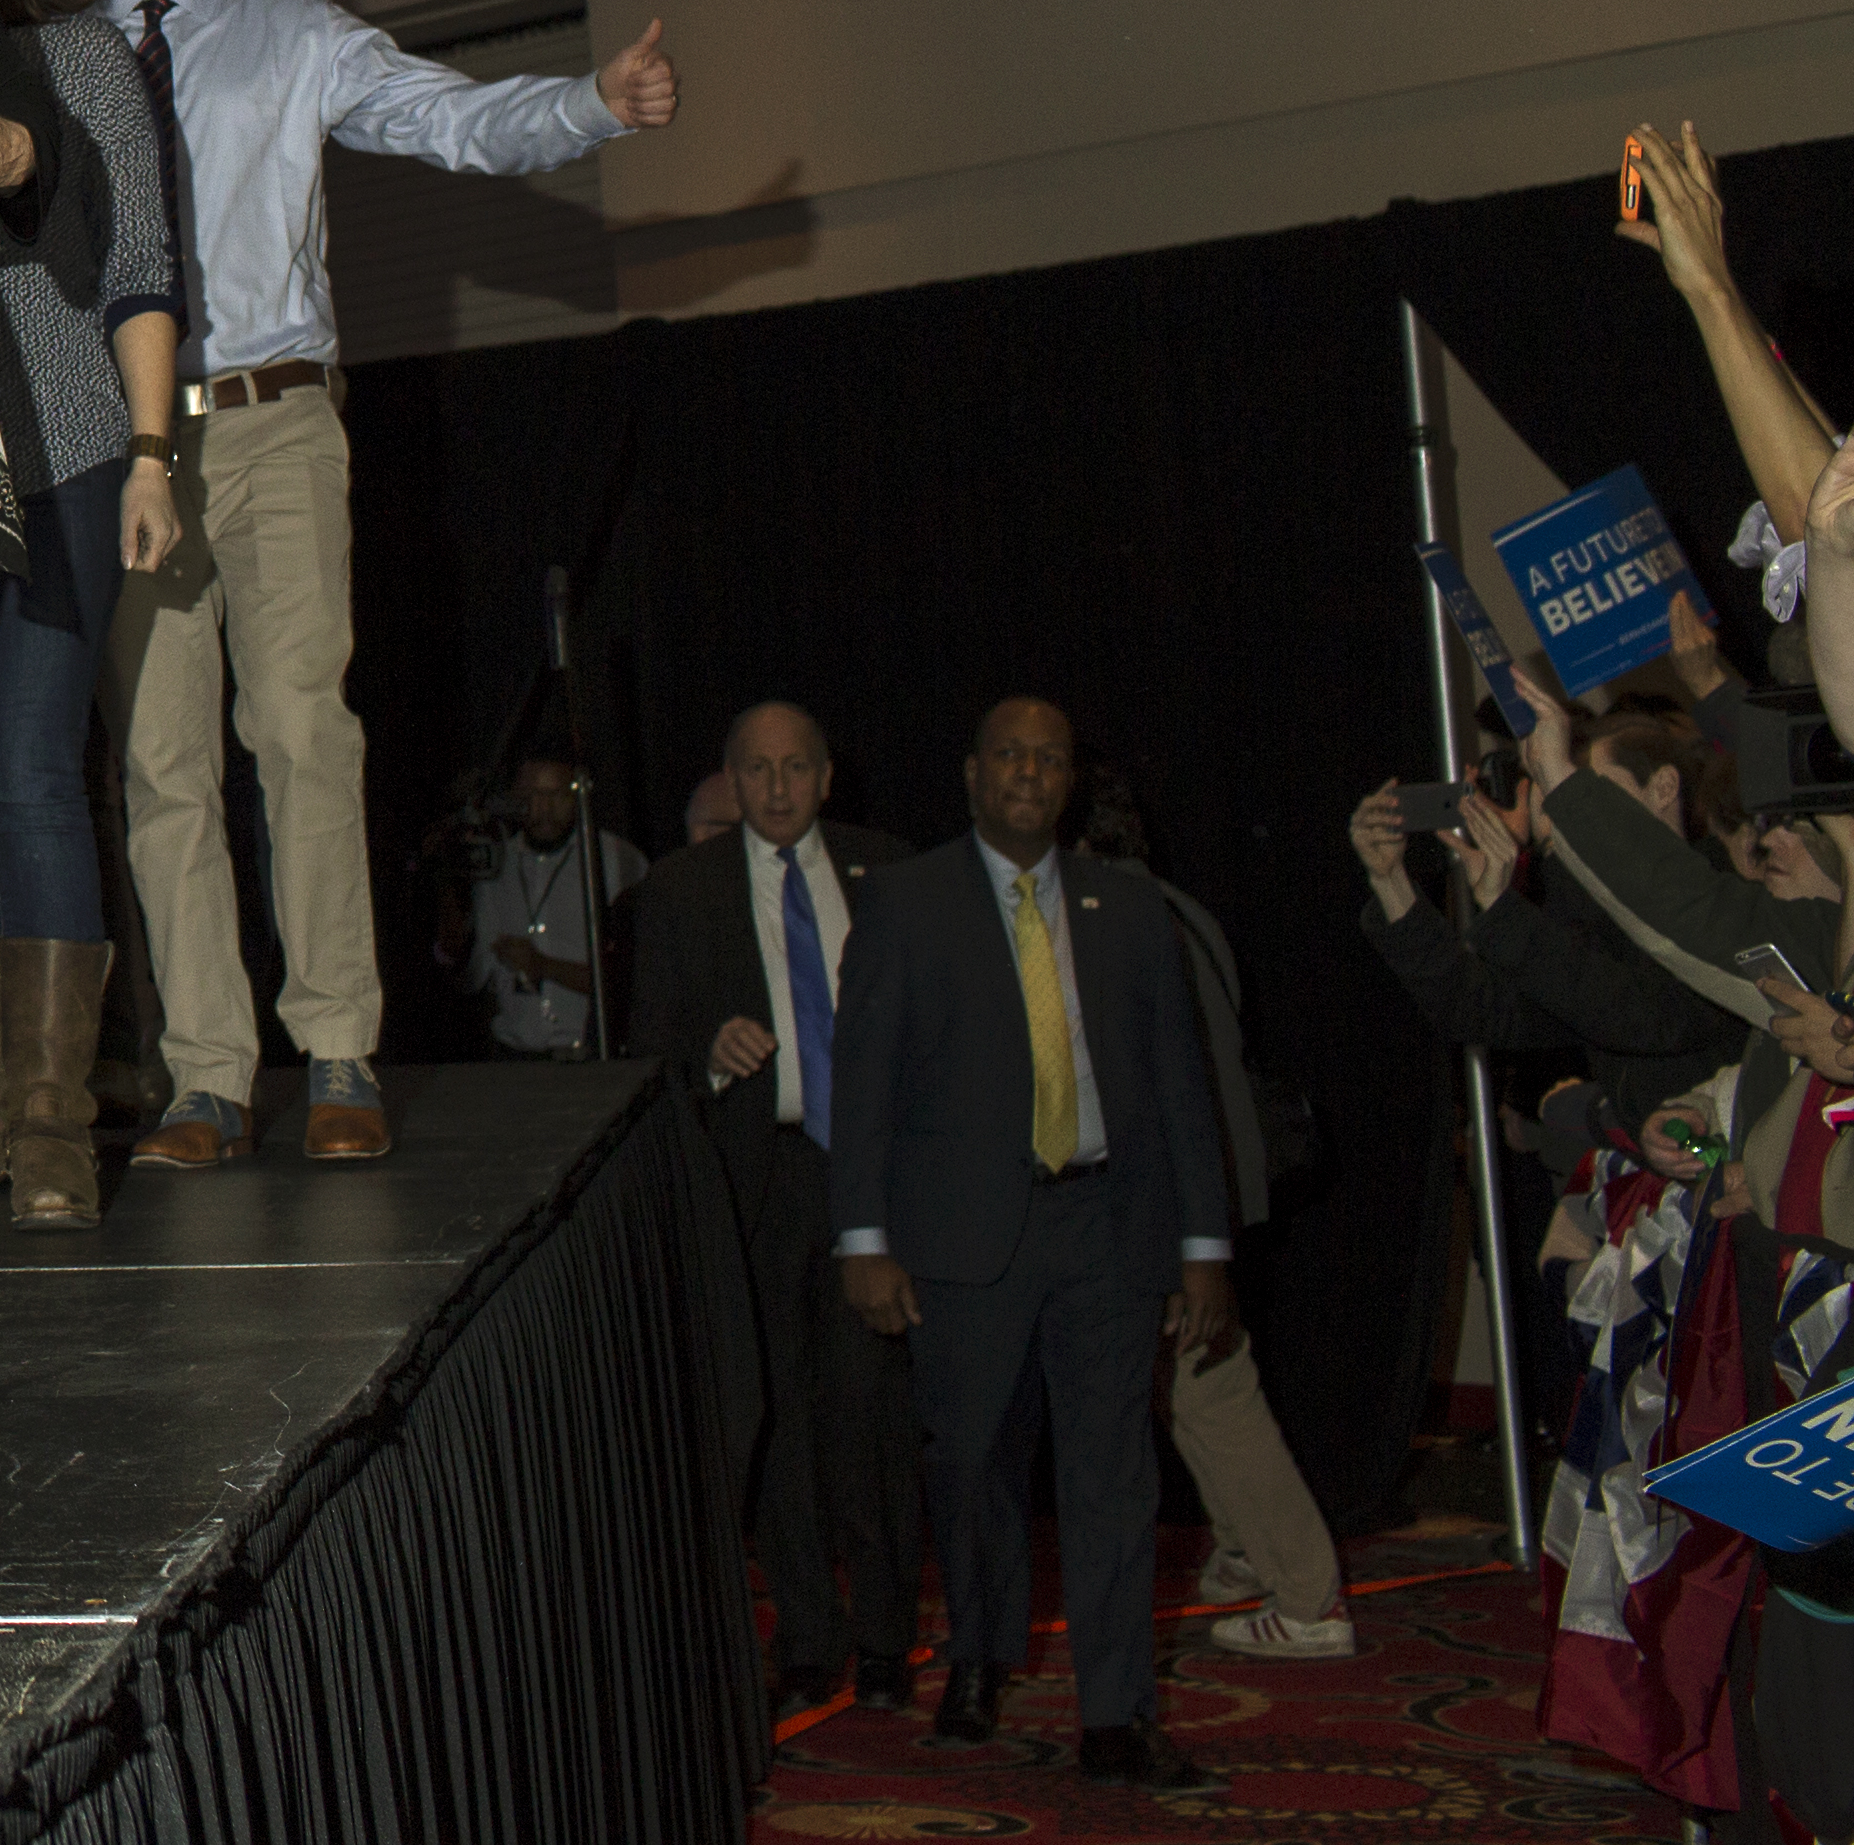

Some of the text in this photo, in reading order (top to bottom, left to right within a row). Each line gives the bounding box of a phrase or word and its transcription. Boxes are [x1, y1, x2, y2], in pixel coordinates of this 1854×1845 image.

[1528, 564, 1552, 598] A
[1549, 508, 1648, 586] FUTUR
[1744, 1438, 1831, 1486] TO
